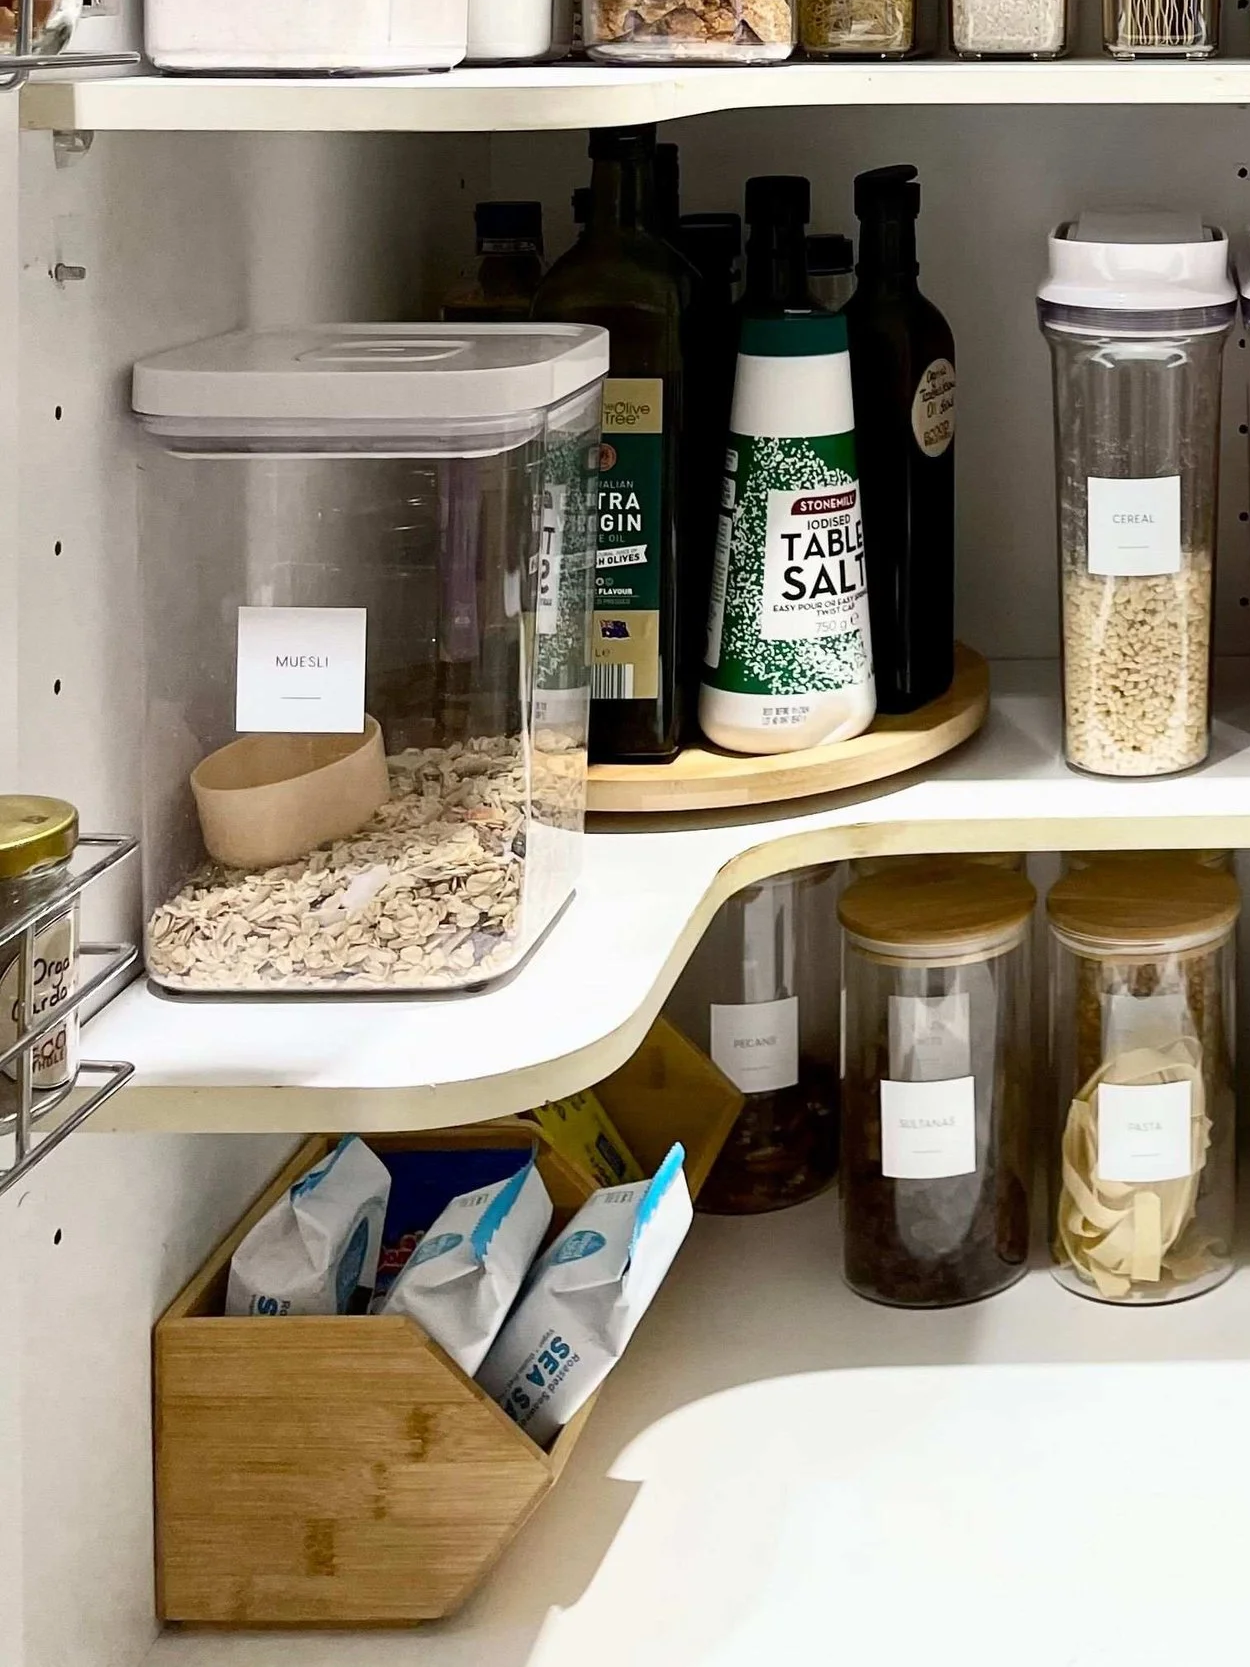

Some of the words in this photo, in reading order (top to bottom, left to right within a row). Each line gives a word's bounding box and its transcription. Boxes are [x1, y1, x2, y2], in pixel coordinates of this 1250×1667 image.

[614, 402, 650, 414] Olive
[604, 412, 636, 425] Tree
[800, 494, 854, 512] STONEMILL
[807, 514, 851, 530] IODISED
[1112, 514, 1155, 524] CEREAL
[609, 534, 626, 543] OIL
[780, 520, 863, 561] TABLE
[607, 554, 640, 564] OLIVES
[781, 551, 865, 601] SALT
[773, 604, 796, 612] EASY
[798, 603, 823, 611] POUR
[816, 607, 840, 616] TWIST
[842, 603, 855, 612] CAP
[816, 622, 836, 632] 750
[840, 621, 847, 631] g
[275, 655, 328, 668] MUESLI
[733, 1035, 778, 1049] PECANS
[1127, 1121, 1163, 1132] PASTA
[526, 1336, 570, 1387] SEA
[547, 1353, 580, 1395] Roasted
